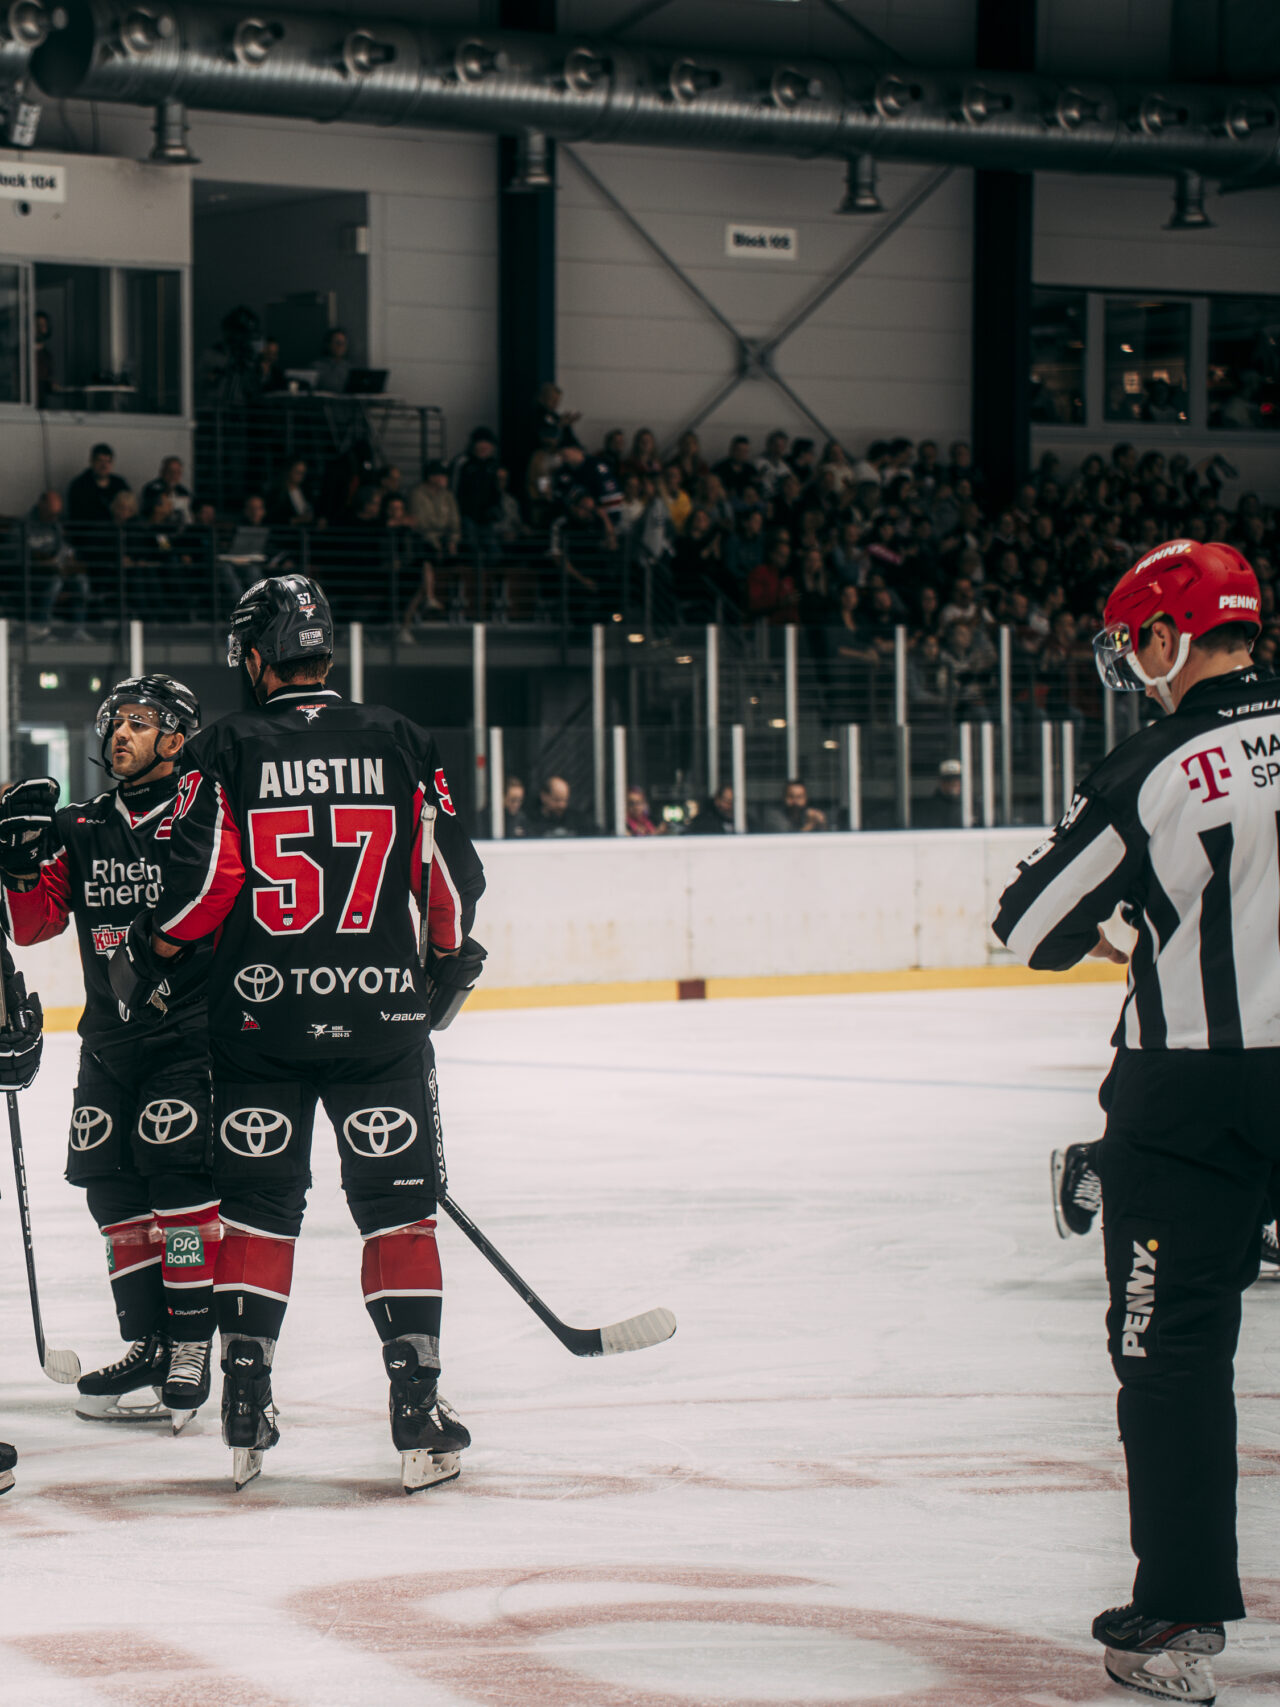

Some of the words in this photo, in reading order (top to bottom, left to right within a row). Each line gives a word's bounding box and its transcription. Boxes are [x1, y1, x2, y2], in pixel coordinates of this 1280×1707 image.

[297, 592, 311, 605] 57
[258, 758, 385, 800] AUSTIN
[92, 856, 163, 885] Rhein
[247, 804, 397, 936] 57
[83, 880, 164, 909] Energ
[290, 965, 416, 995] TOYOTA
[432, 1101, 447, 1185] TOYOTA
[167, 1252, 202, 1265] Bank
[173, 1236, 200, 1252] psd
